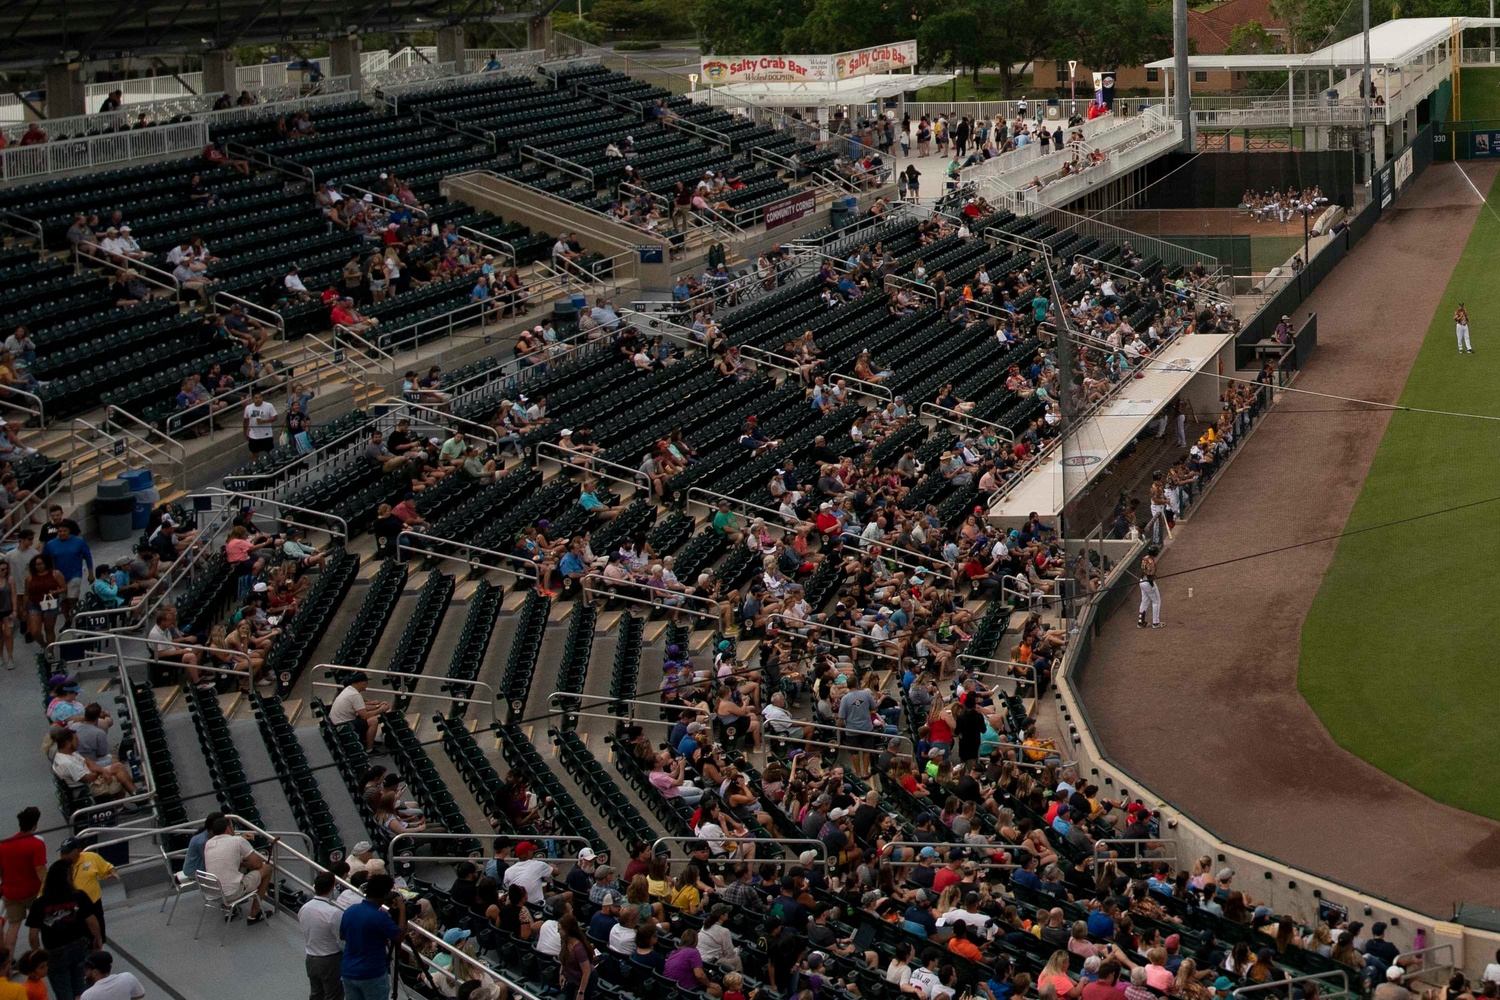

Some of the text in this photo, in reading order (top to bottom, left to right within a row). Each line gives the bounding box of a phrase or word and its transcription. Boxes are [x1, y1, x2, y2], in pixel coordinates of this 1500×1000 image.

[730, 59, 757, 75] Salty
[760, 57, 786, 69] Crab
[788, 60, 808, 76] Bar
[849, 50, 870, 74] Salty
[872, 46, 890, 62] Crab
[892, 48, 906, 64] Bar
[766, 204, 796, 223] COMMUNITY
[796, 198, 815, 212] CORNER
[90, 616, 105, 625] 110
